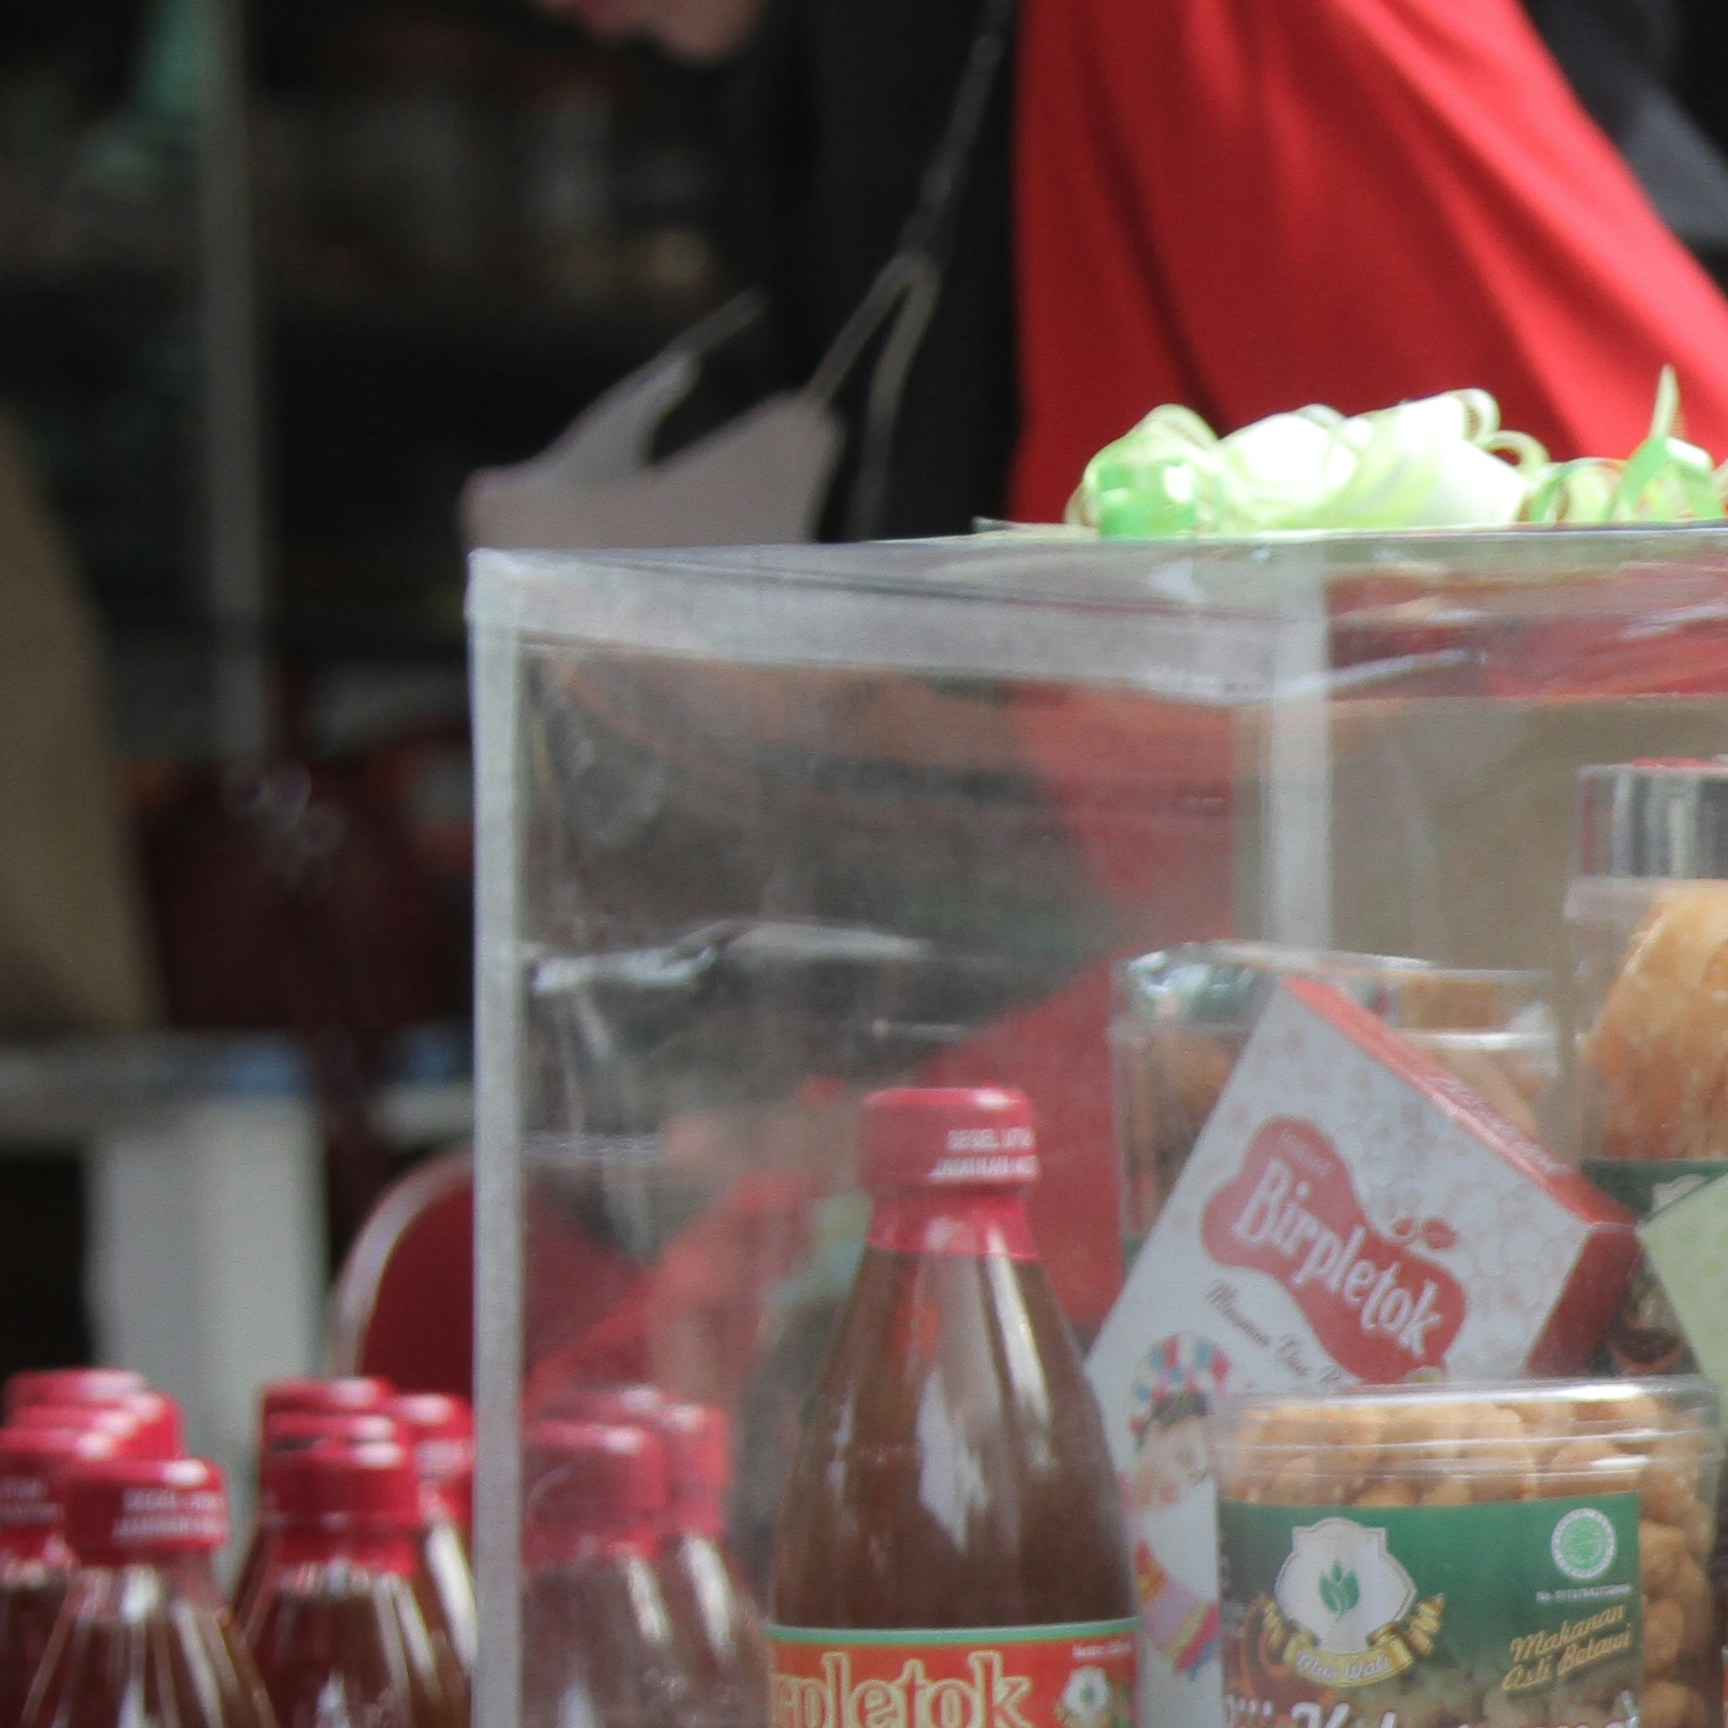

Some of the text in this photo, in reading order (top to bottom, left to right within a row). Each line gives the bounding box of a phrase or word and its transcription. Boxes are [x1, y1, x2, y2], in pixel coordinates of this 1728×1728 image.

[1233, 1156, 1444, 1358] Birpletok
[1509, 1604, 1627, 1658] Makanan
[1557, 1623, 1633, 1677] Betawi
